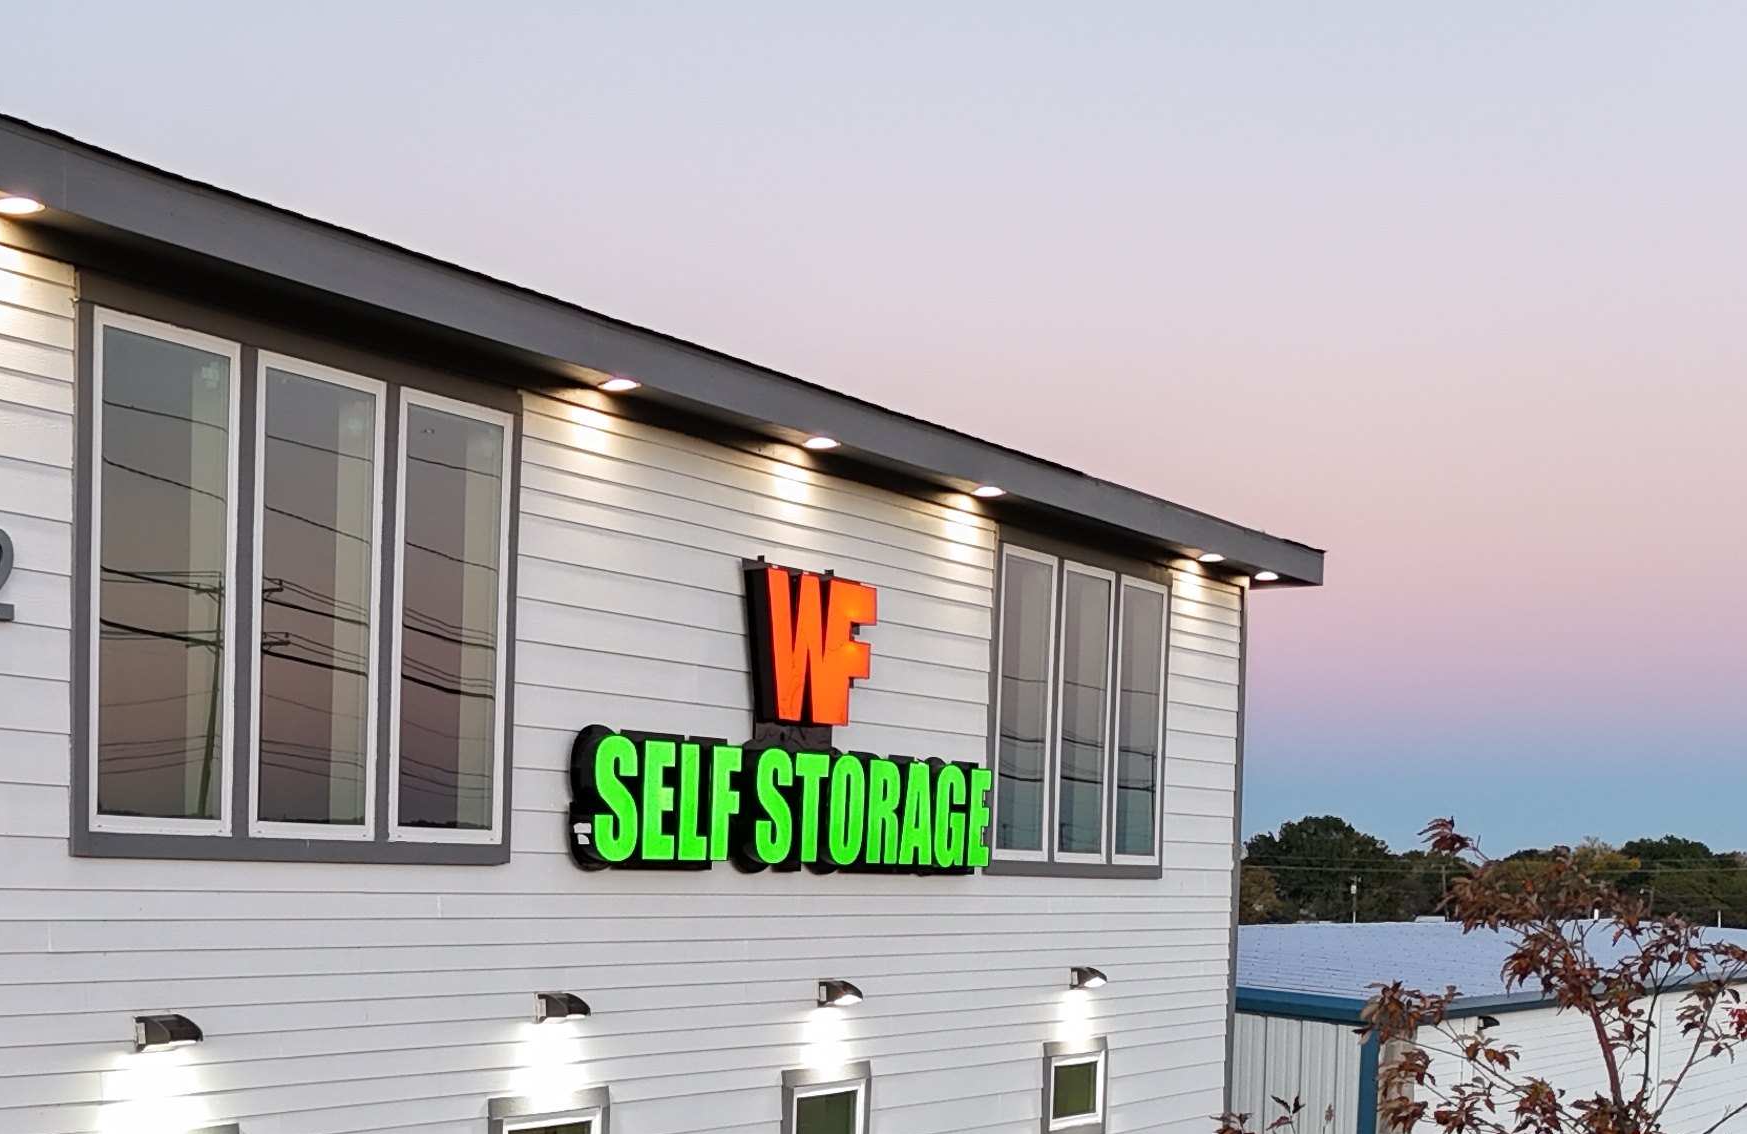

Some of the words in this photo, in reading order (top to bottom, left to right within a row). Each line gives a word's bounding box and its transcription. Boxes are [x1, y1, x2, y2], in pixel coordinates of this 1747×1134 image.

[763, 566, 879, 727] WF
[593, 733, 744, 863] SELF
[754, 747, 993, 868] STORAGE
